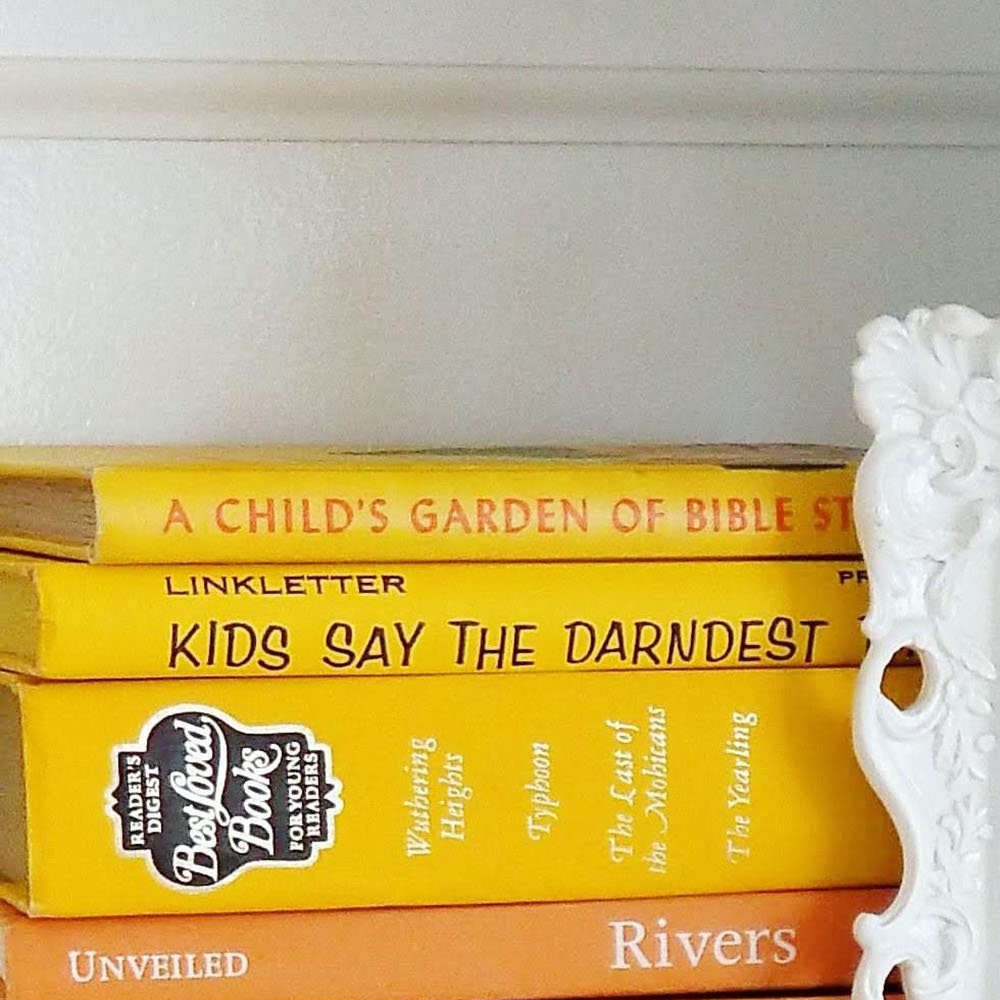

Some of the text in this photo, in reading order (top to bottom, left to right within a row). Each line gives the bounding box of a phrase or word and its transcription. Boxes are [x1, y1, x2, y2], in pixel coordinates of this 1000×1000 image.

[163, 499, 193, 533] A
[216, 499, 389, 533] CHILD'S
[411, 498, 588, 533] GARDEN
[612, 499, 665, 532] OF
[687, 498, 796, 532] BIBLE
[165, 575, 407, 596] LINKLETTER
[168, 621, 290, 670] KIDS
[323, 621, 425, 668] SAY
[449, 620, 537, 669] THE
[565, 617, 829, 665] DARNDEST
[127, 755, 145, 845] READER'S
[145, 764, 162, 834] DIGEST
[170, 715, 231, 882] Best Loved
[228, 743, 282, 856] Books
[286, 741, 304, 852] FOR YOUNG
[303, 752, 321, 837] READERS
[404, 735, 437, 858] Wuthering
[438, 752, 473, 841] Heights
[525, 741, 560, 841] Typhoon
[605, 718, 639, 864] The Last of
[641, 704, 668, 874] the Mohicans
[726, 710, 758, 864] The Yearling
[608, 917, 798, 971] Rivers
